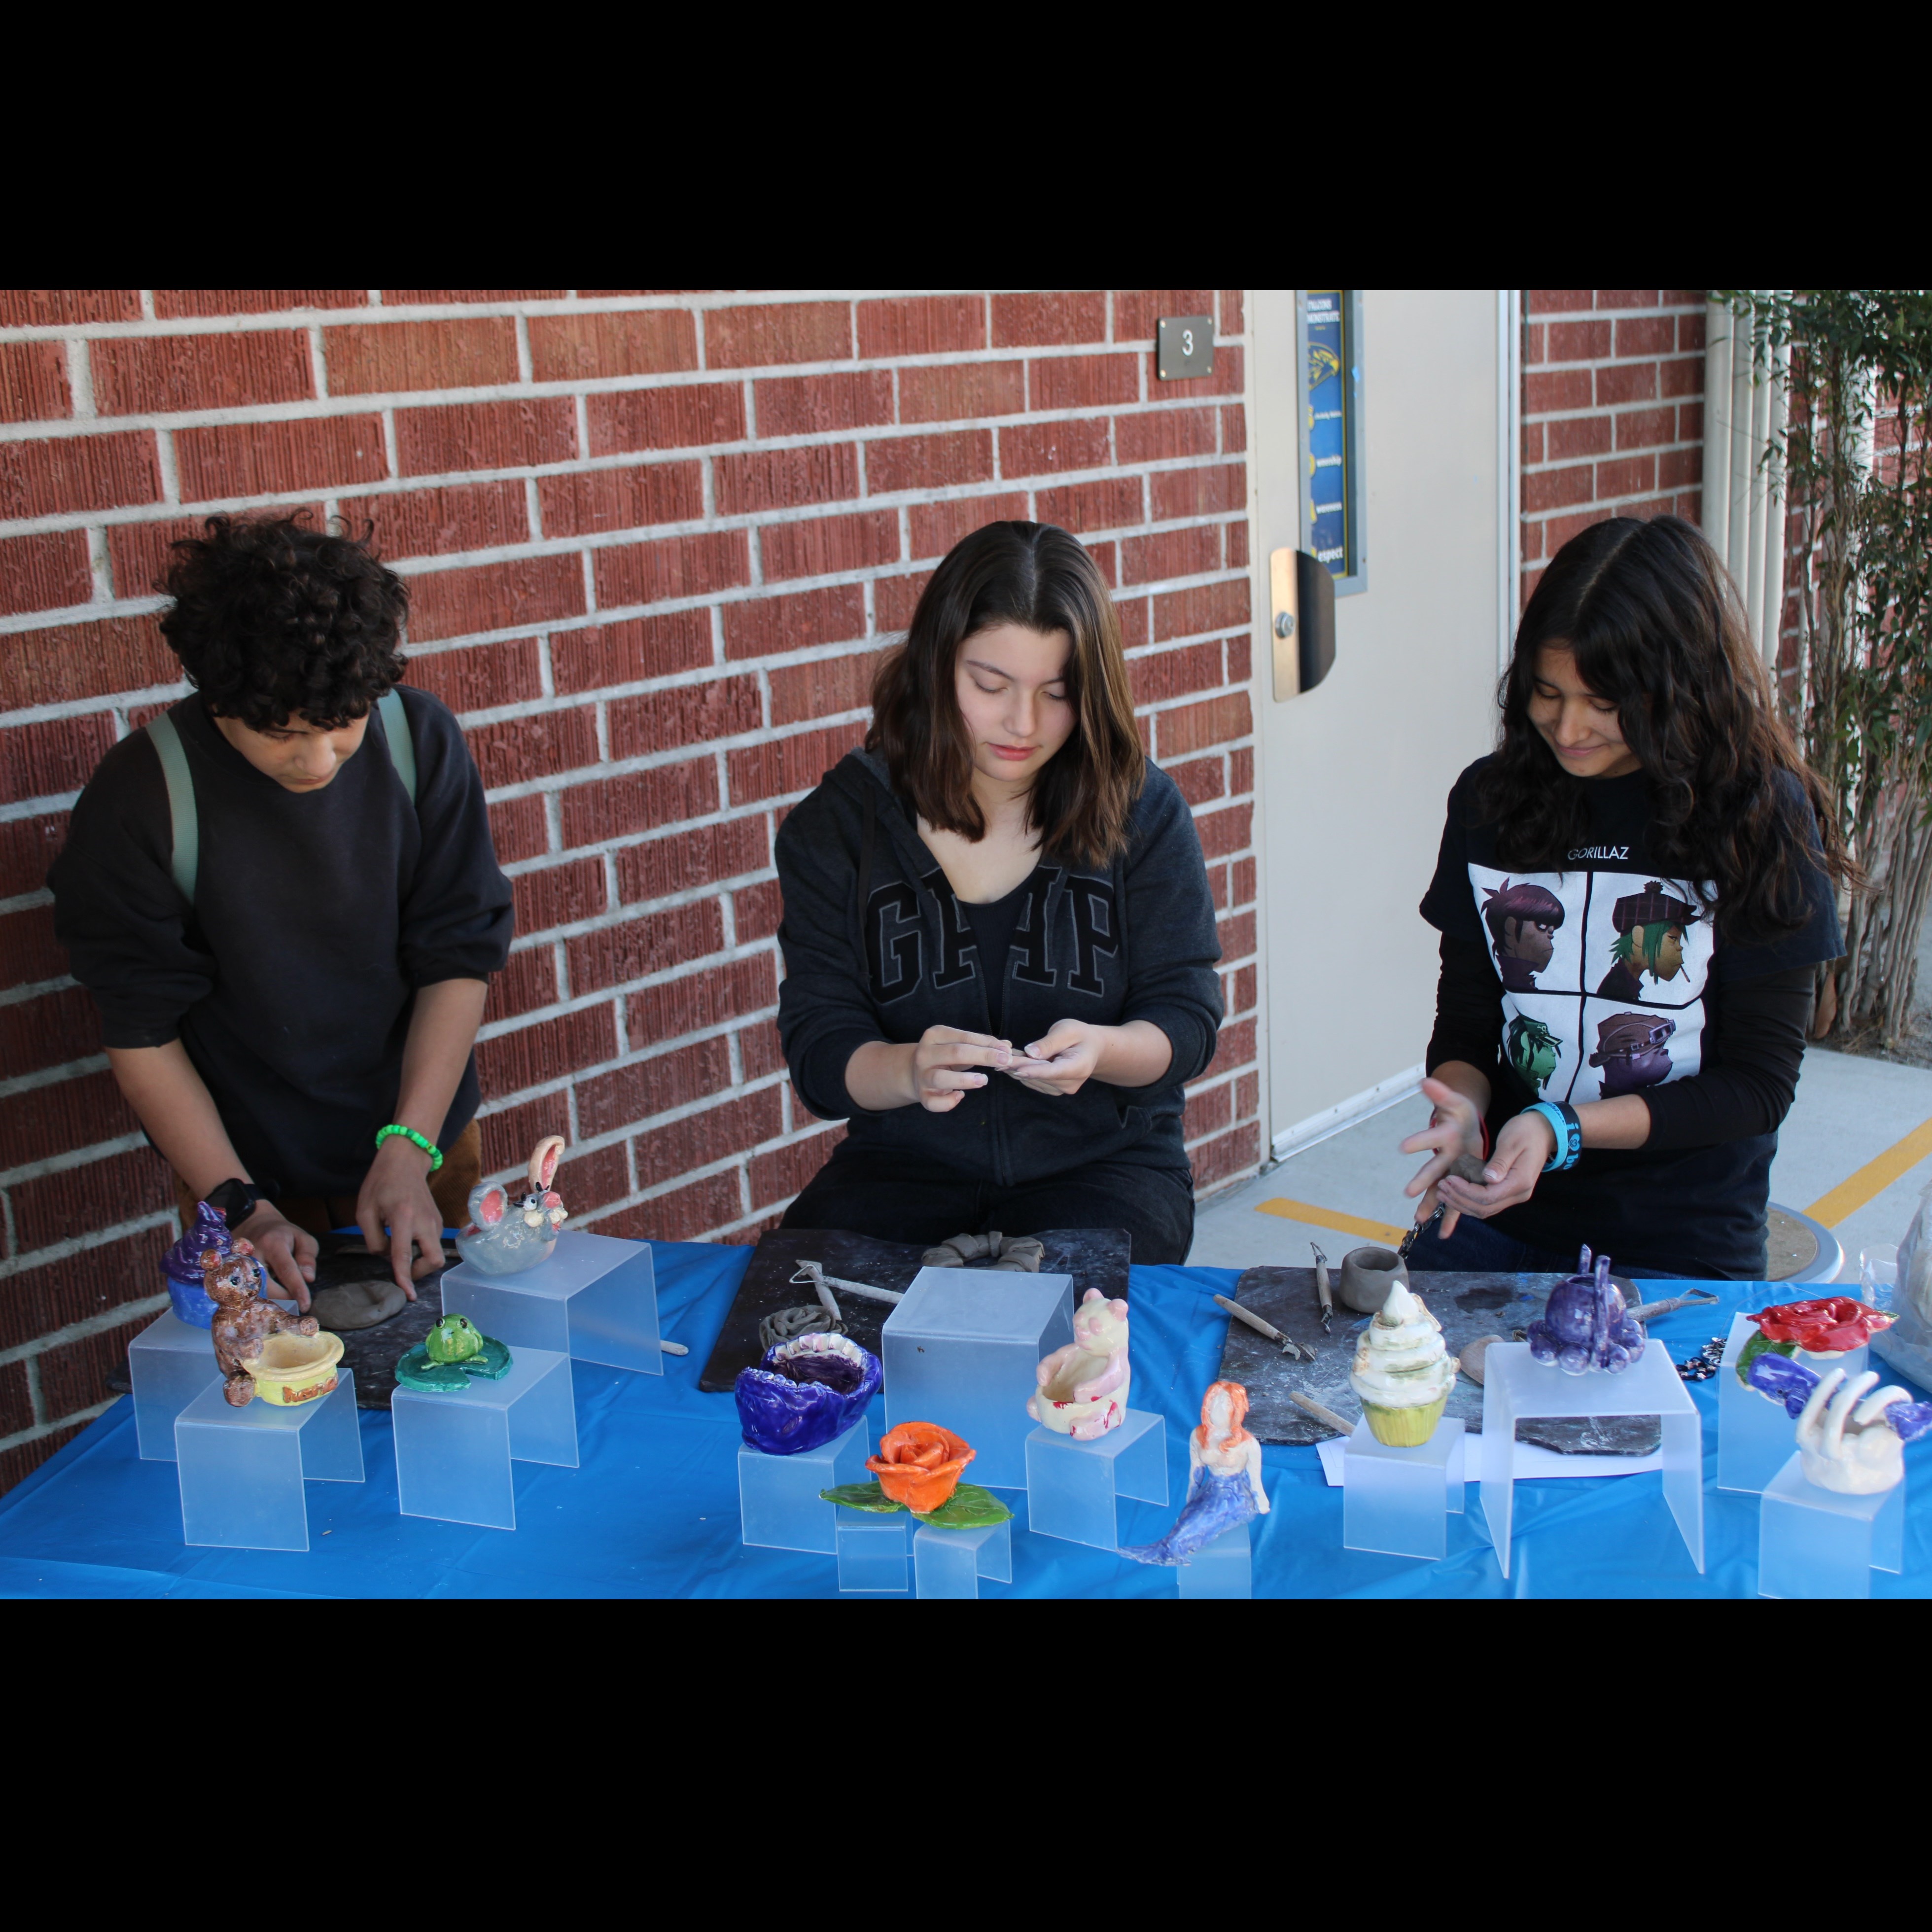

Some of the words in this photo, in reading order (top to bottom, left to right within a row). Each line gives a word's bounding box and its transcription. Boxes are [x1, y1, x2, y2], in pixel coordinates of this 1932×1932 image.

[1306, 310, 1340, 324] MONSTRATE
[1182, 329, 1194, 356] 3
[1310, 546, 1344, 562] espect
[1568, 845, 1629, 860] GORILLAZ
[867, 865, 1119, 1005] GAP
